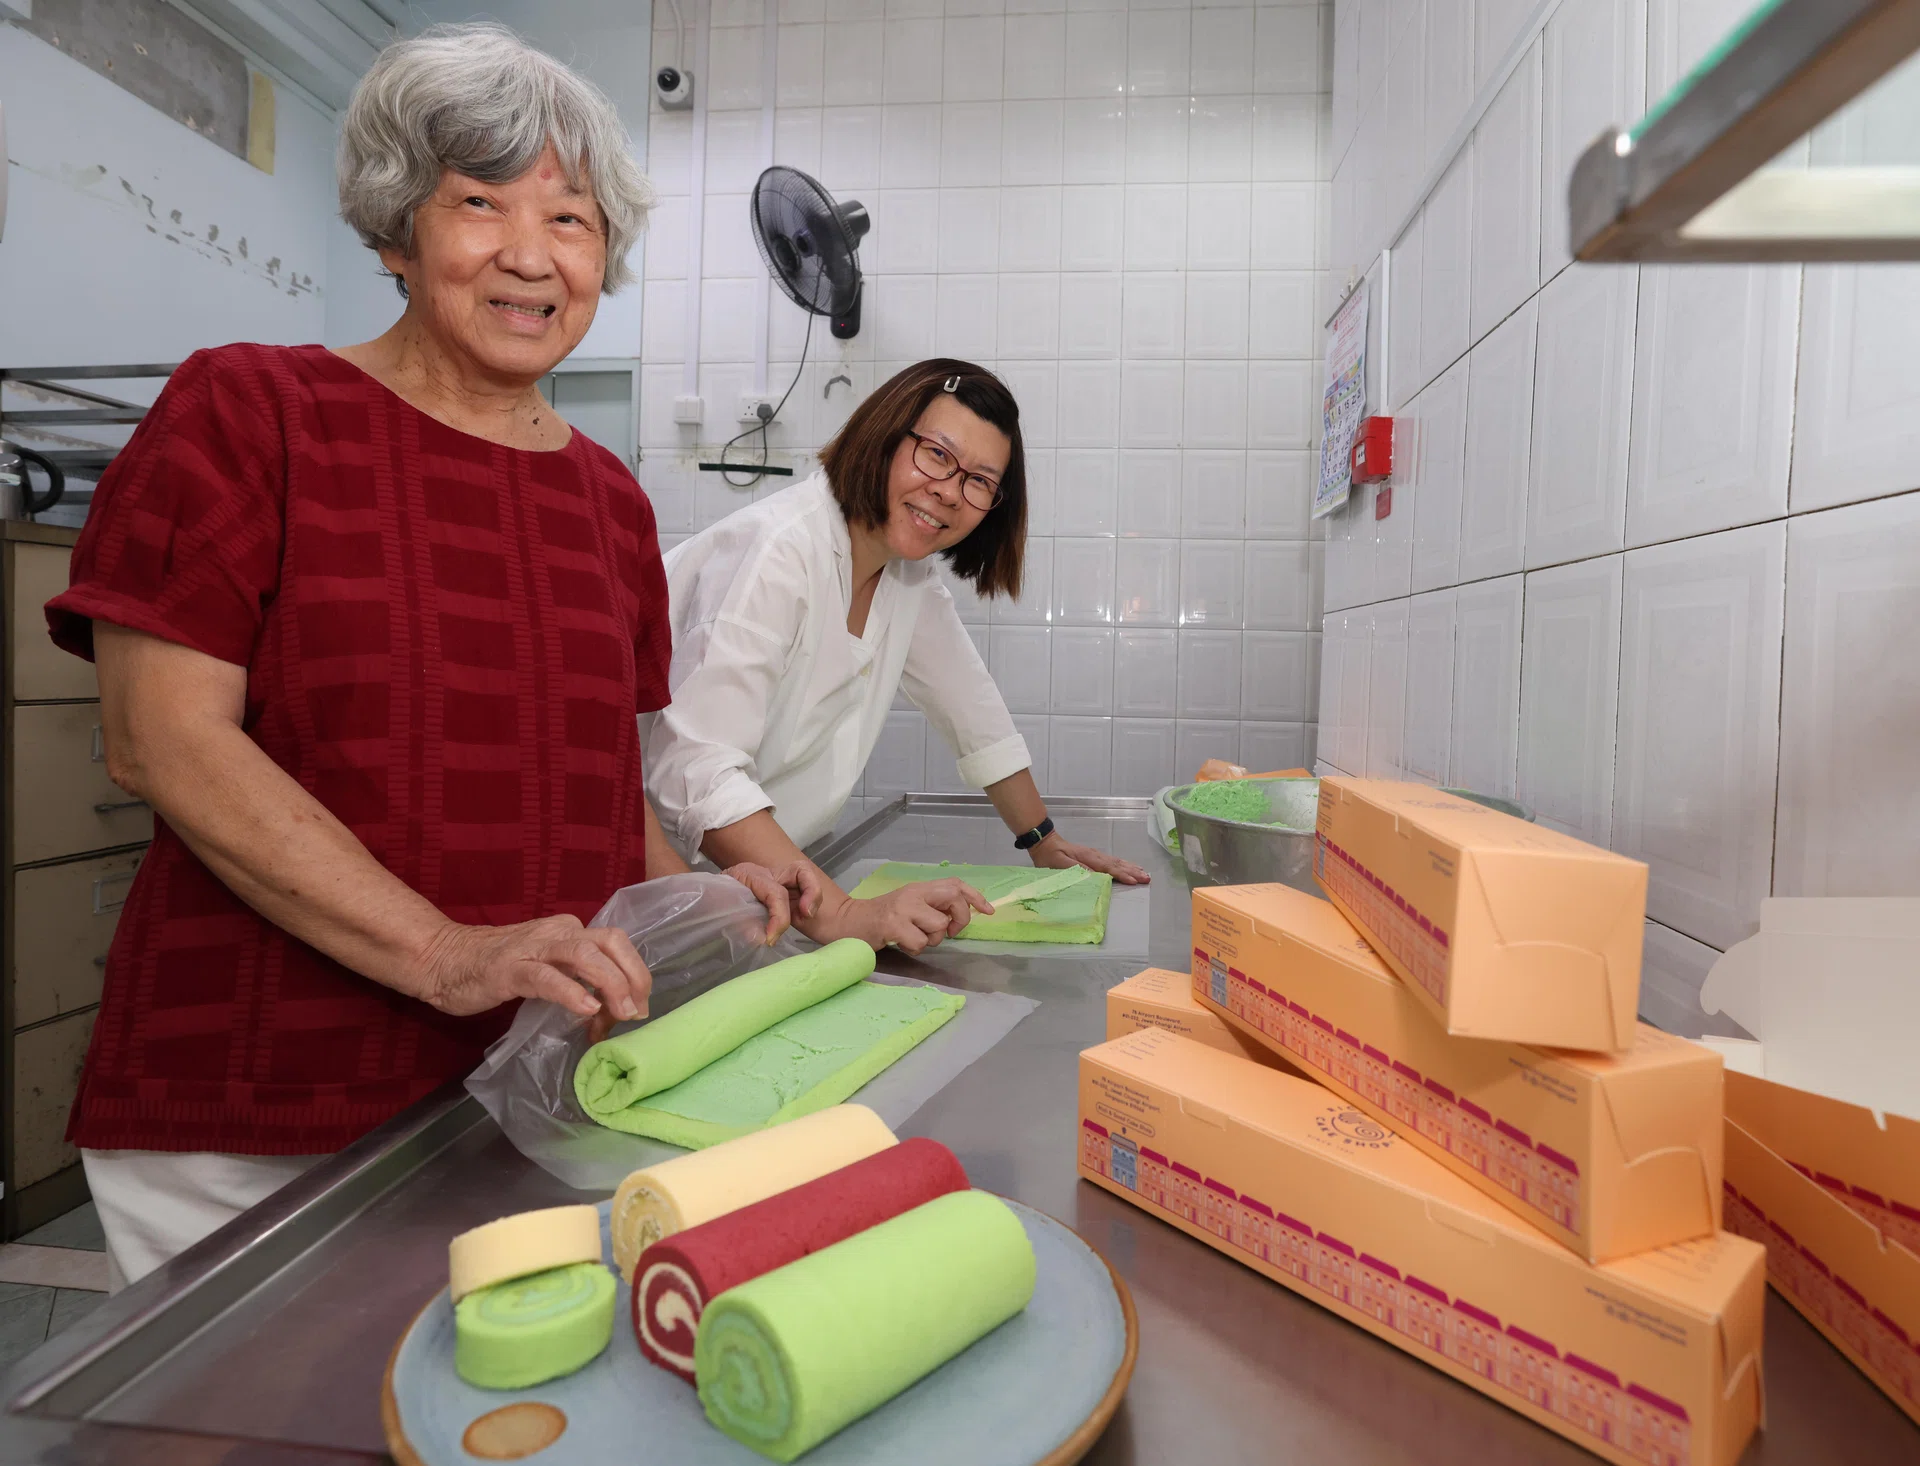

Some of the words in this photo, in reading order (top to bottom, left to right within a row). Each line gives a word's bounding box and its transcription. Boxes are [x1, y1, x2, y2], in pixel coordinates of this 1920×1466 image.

[1138, 1011, 1155, 1020] Airport
[1154, 1020, 1172, 1029] Changi
[1343, 1138, 1391, 1150] SHOP
